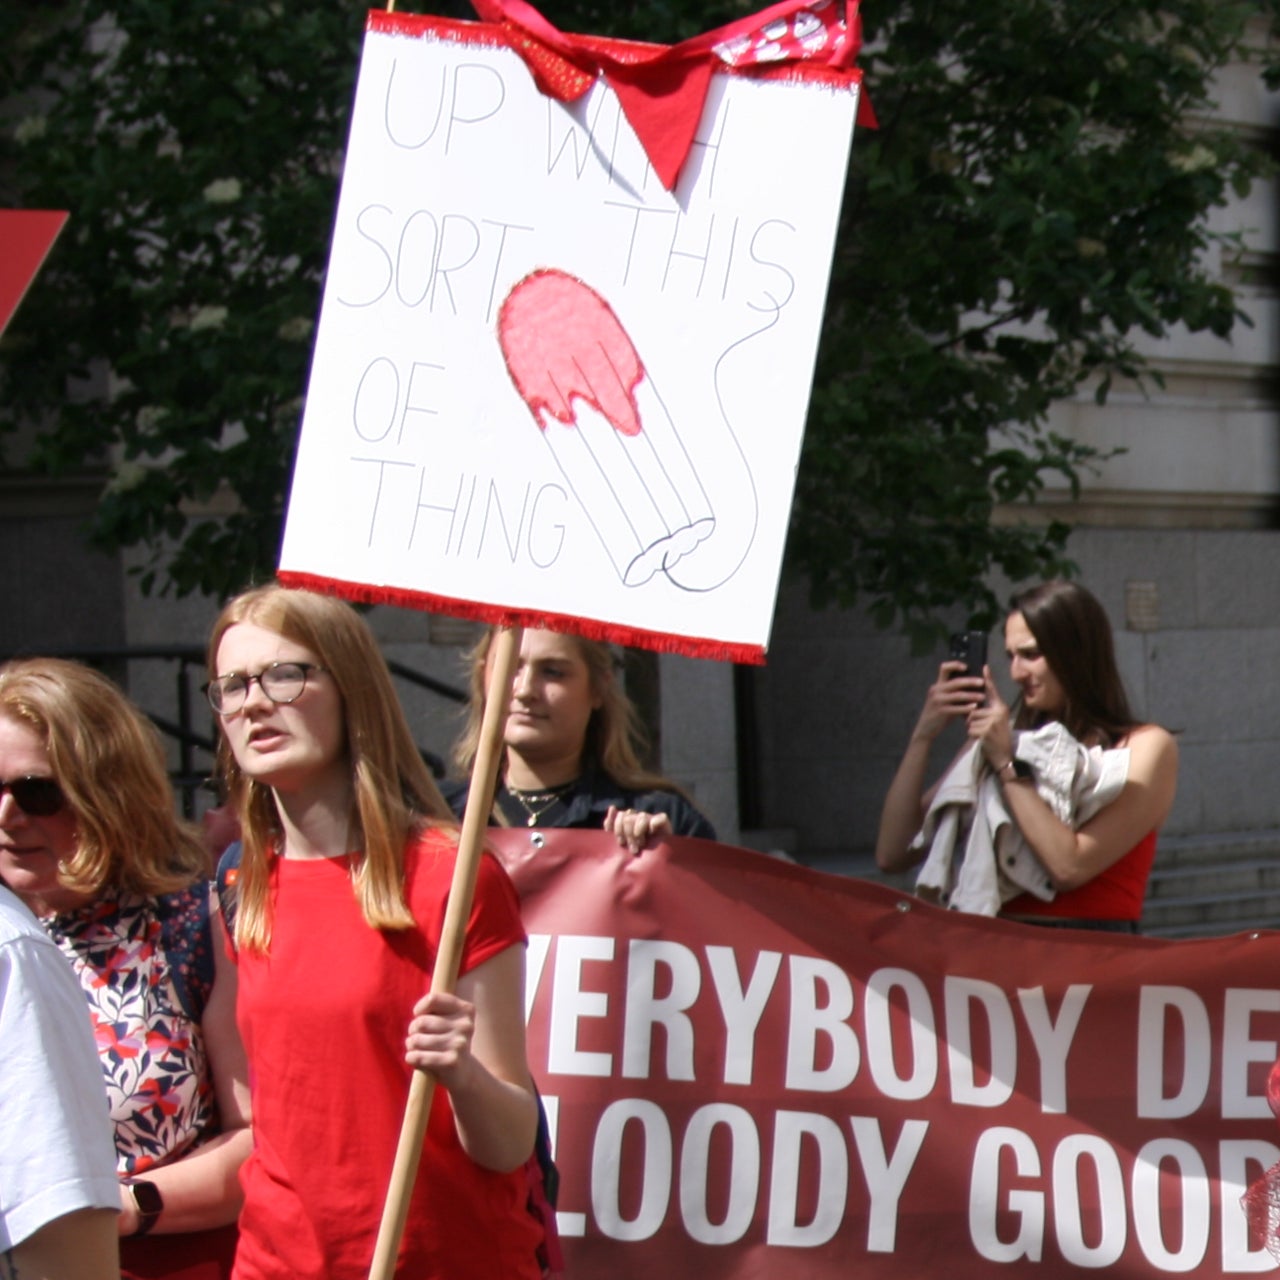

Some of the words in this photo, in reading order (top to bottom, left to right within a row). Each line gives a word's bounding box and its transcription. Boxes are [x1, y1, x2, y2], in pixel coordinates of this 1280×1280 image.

[385, 58, 505, 156] UP
[336, 204, 535, 324] SORT
[603, 200, 797, 313] THIS
[353, 357, 446, 445] OF
[350, 457, 568, 569] THING
